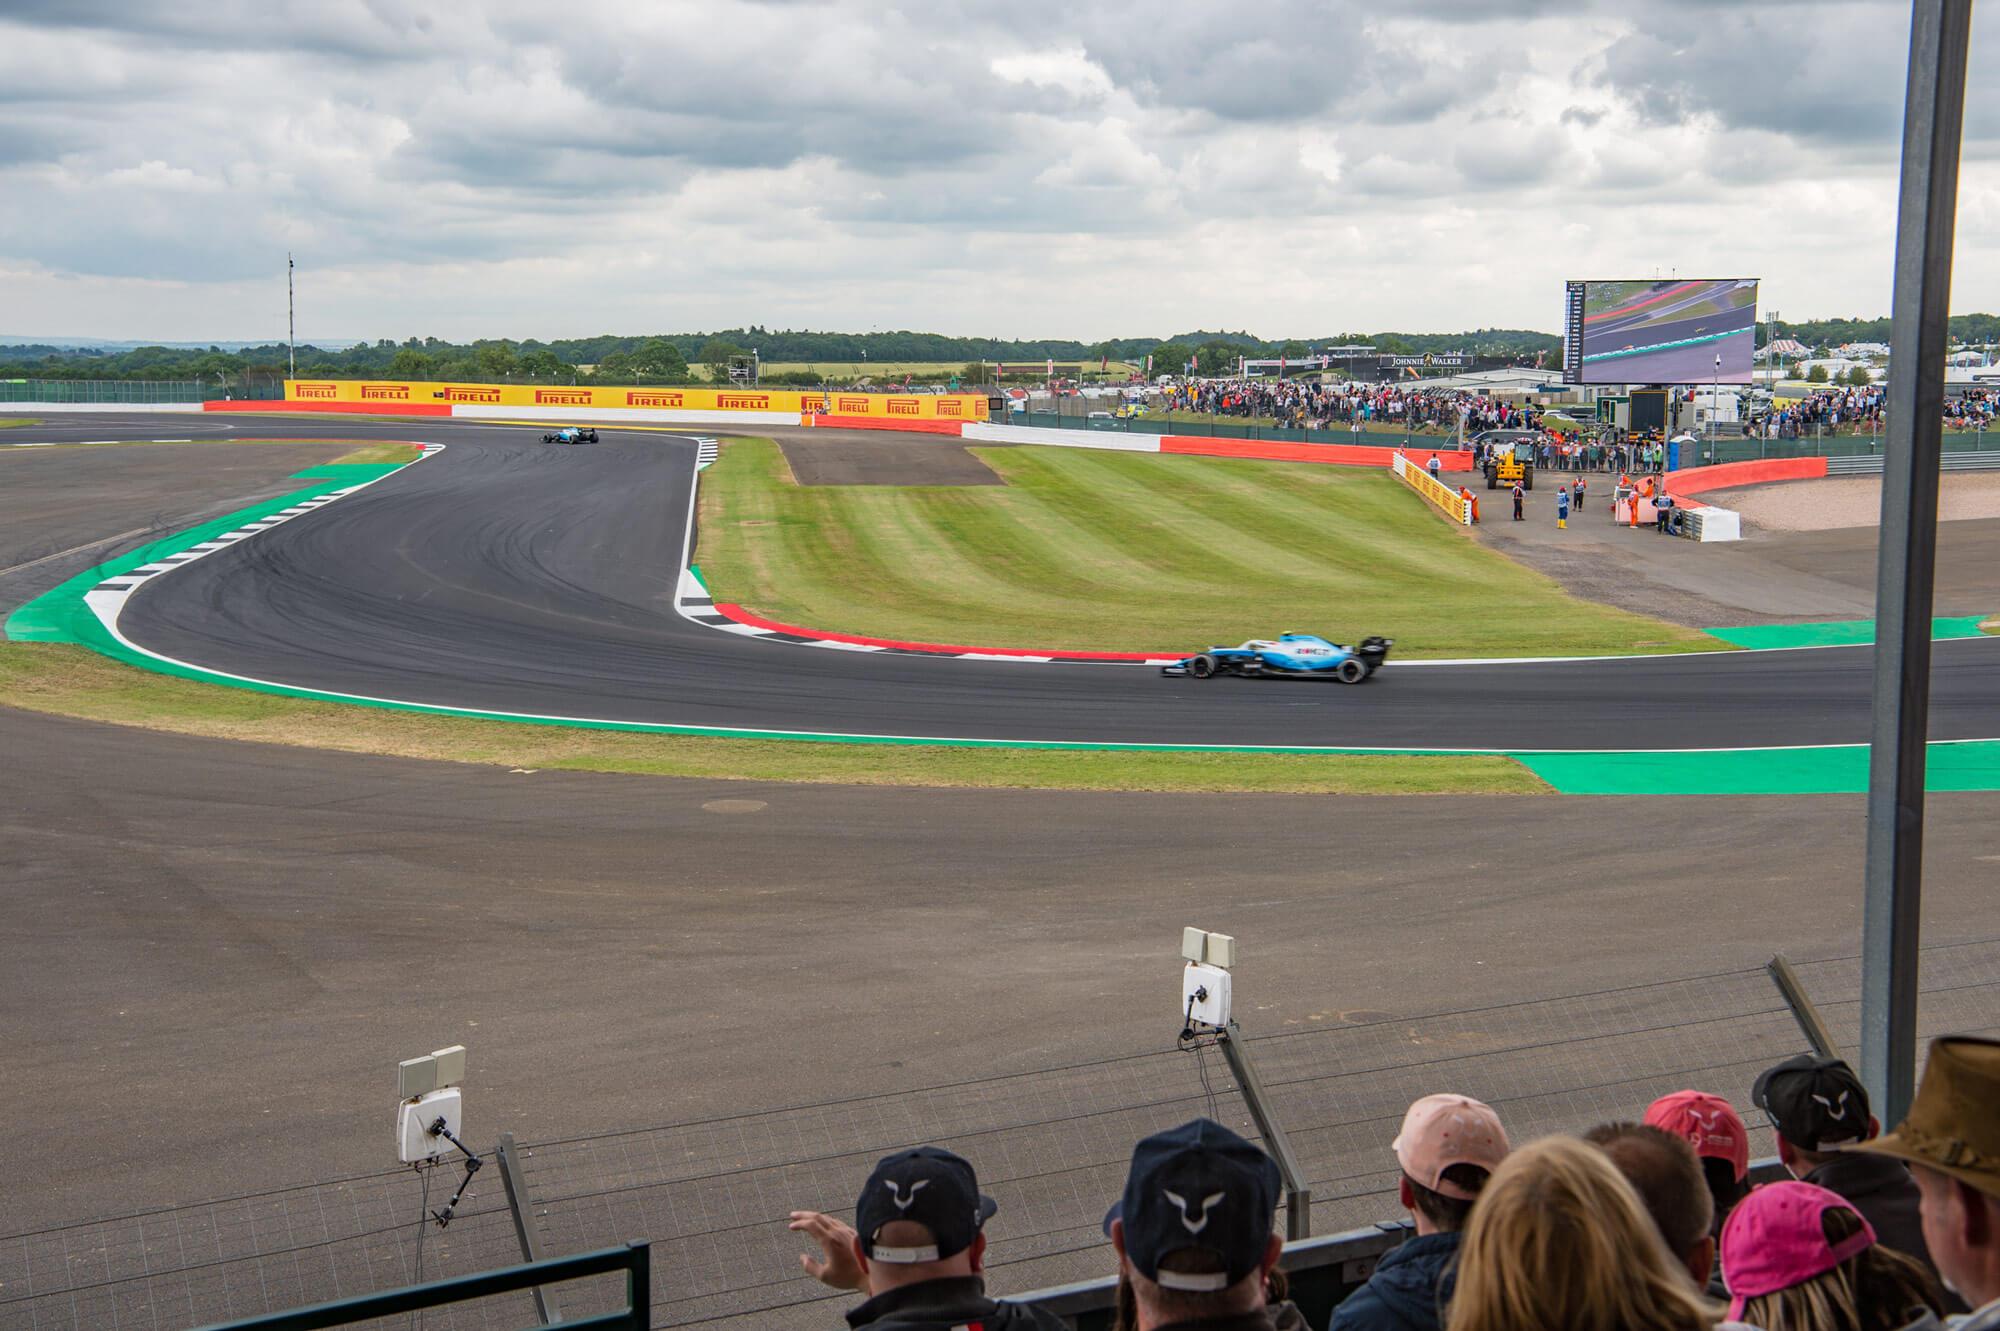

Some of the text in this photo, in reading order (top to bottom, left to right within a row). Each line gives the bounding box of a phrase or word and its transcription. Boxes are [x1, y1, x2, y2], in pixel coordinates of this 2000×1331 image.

[1392, 357, 1462, 367] JOHNNIE WALKER
[296, 384, 336, 398] PIRELLI
[361, 385, 409, 399] PIRELLI
[444, 387, 500, 402] PIRELLI
[535, 390, 592, 404] PIRELLI
[626, 392, 683, 407] PIRELLI
[717, 394, 769, 409] PIRELLI
[839, 398, 869, 413] PIRELLI
[887, 399, 919, 414] PIRELLI
[937, 400, 961, 416] PIRELLI
